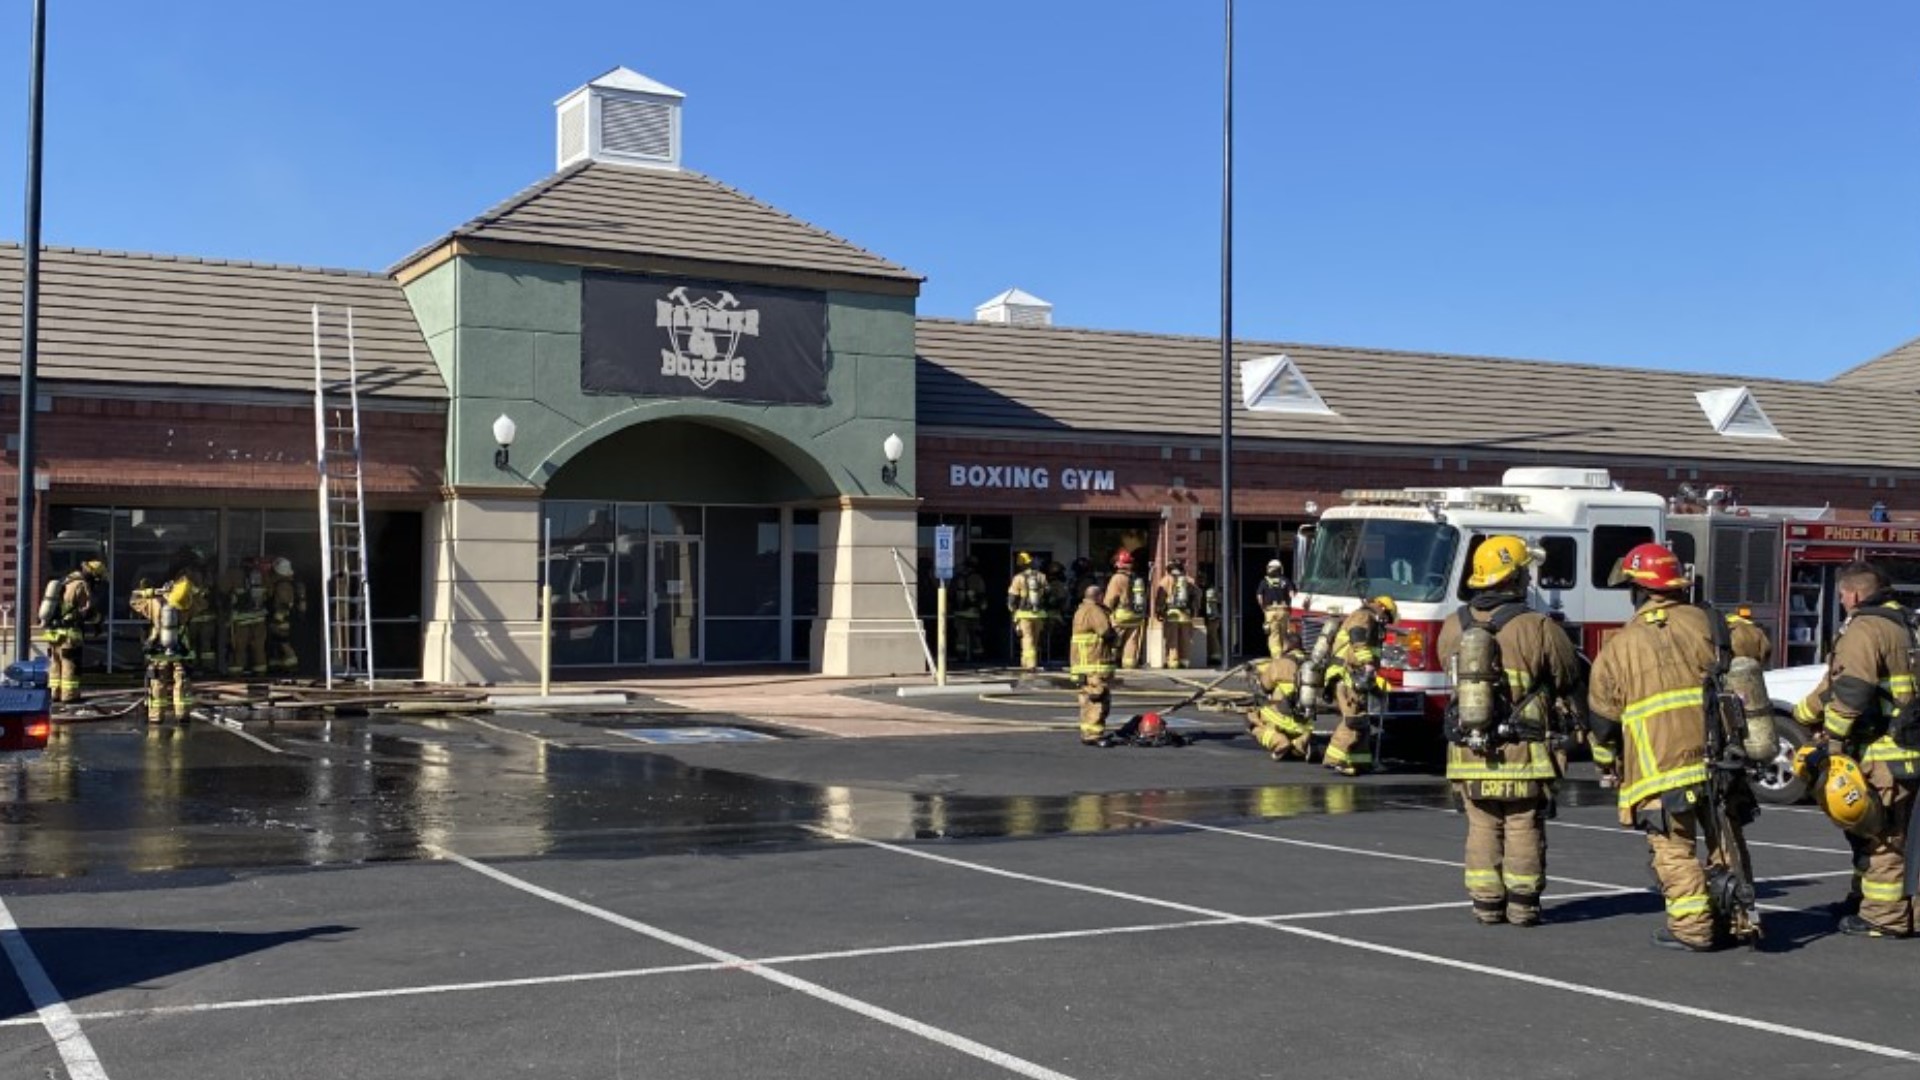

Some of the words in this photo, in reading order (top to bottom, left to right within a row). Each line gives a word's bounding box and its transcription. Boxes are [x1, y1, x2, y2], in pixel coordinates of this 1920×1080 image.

[951, 465, 1049, 488] BOXING
[1061, 468, 1115, 490] GYM
[1824, 526, 1885, 542] PHOENIX
[1888, 528, 1920, 543] FIRE
